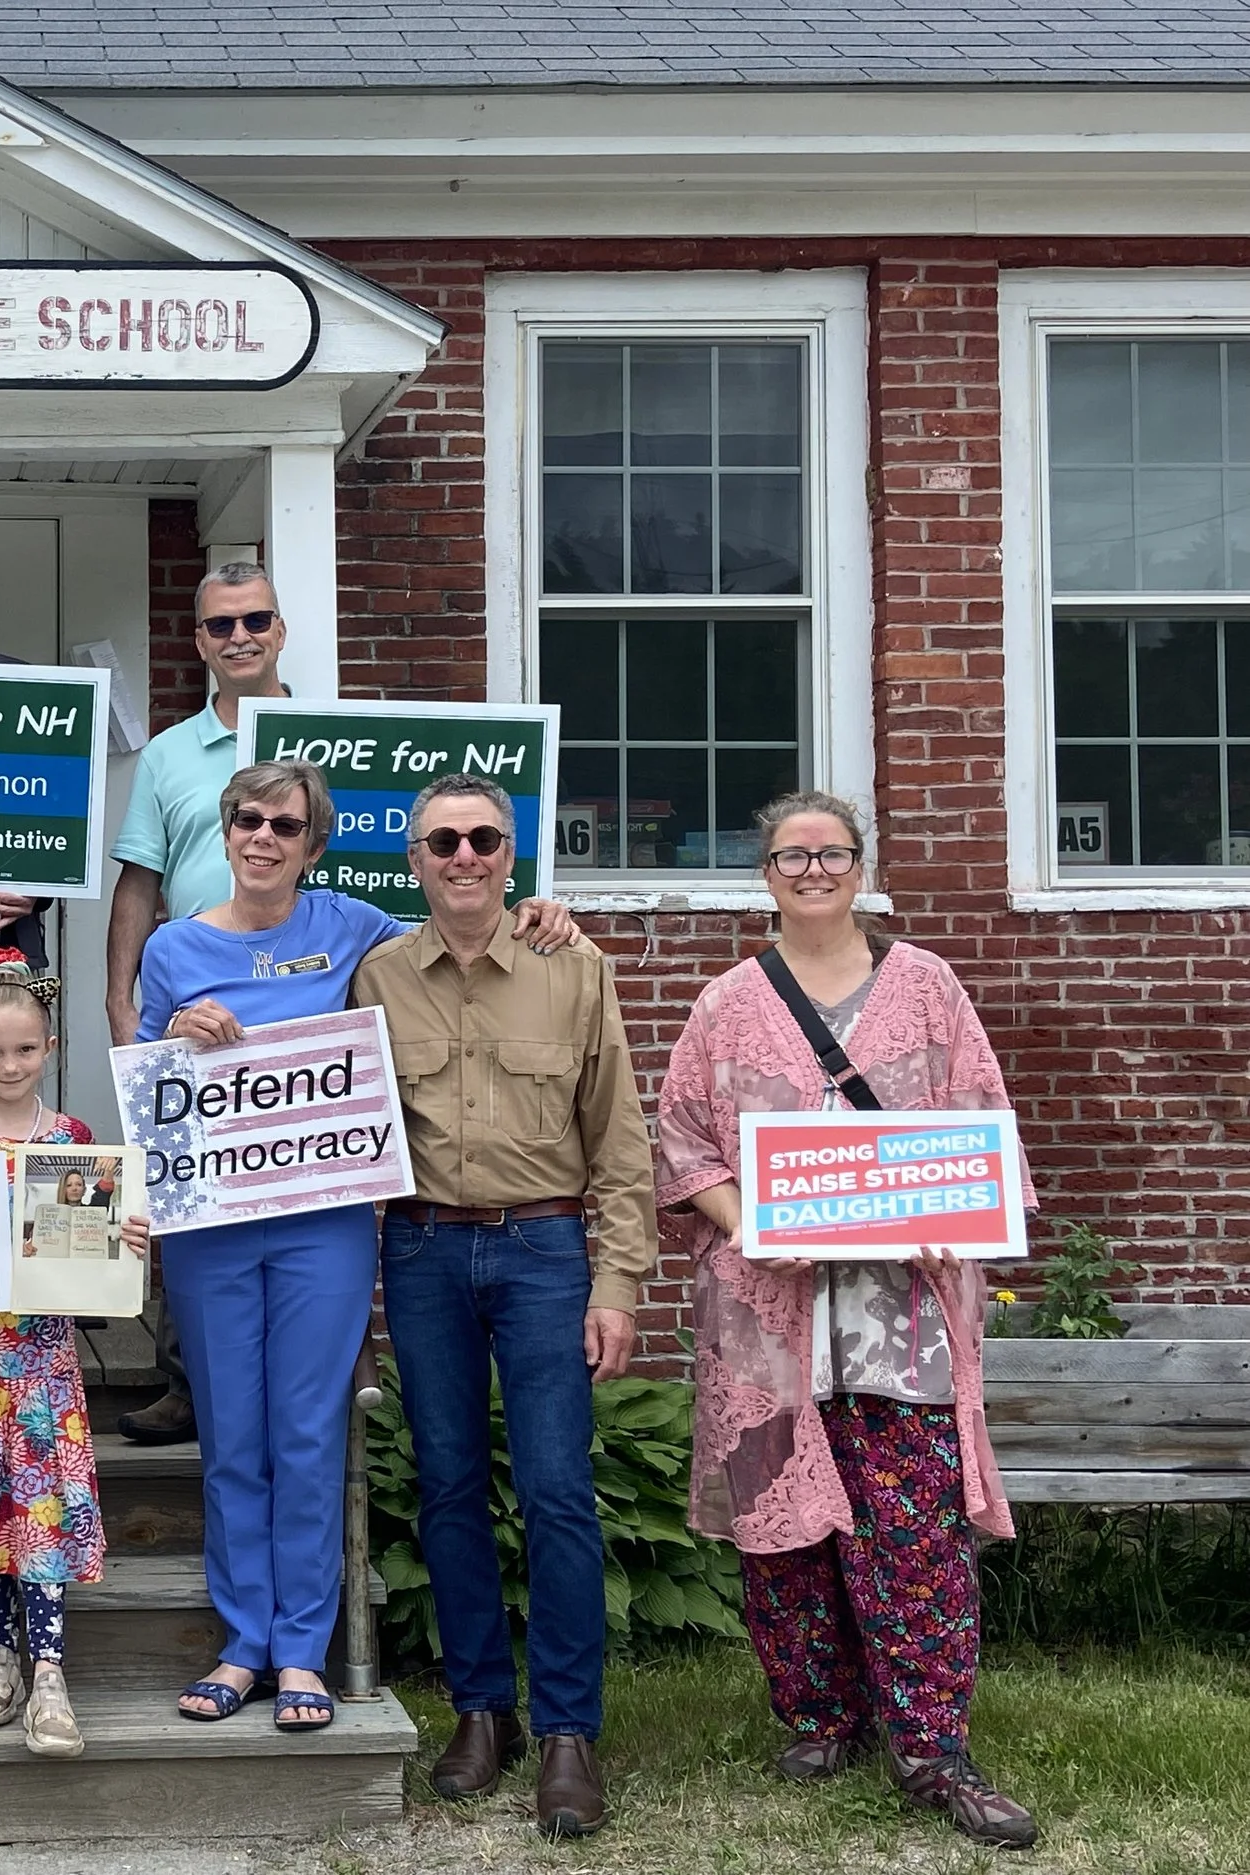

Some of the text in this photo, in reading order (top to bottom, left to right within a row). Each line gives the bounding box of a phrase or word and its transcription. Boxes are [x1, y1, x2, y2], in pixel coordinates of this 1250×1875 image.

[38, 295, 265, 354] SCHOOL
[16, 704, 78, 736] NH
[273, 737, 526, 775] HOPE for NH
[337, 810, 376, 837] pe
[1058, 817, 1102, 853] A5
[154, 1050, 353, 1126] Defend
[145, 1122, 392, 1188] Democracy
[769, 1132, 986, 1170] STRONG WOMEN
[771, 1158, 989, 1198] RAISE STRONG
[772, 1186, 991, 1228] DAUGHTERS
